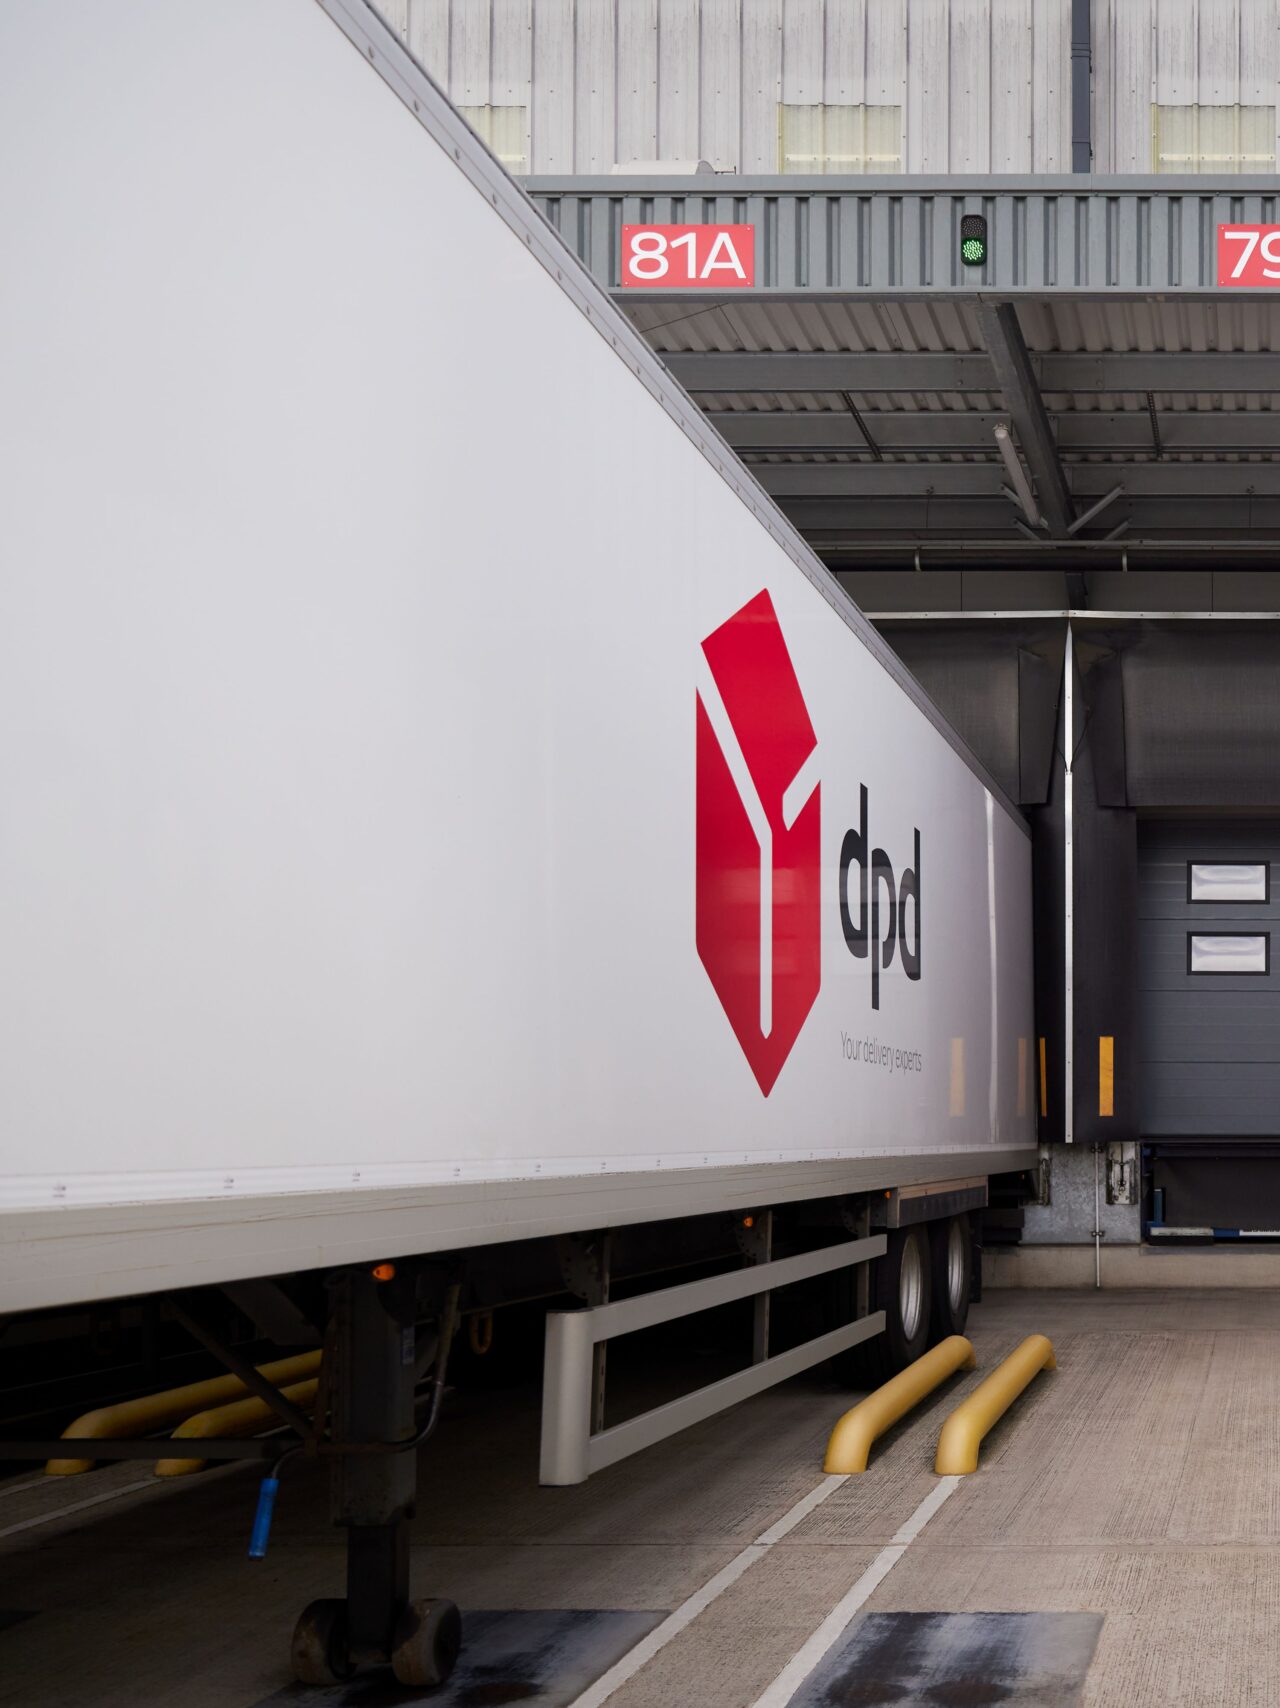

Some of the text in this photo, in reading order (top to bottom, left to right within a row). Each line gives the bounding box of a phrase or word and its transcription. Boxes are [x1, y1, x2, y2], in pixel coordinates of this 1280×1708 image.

[629, 232, 746, 279] 81A
[839, 782, 921, 1010] dpd
[840, 1031, 922, 1075] Your delivery experts
